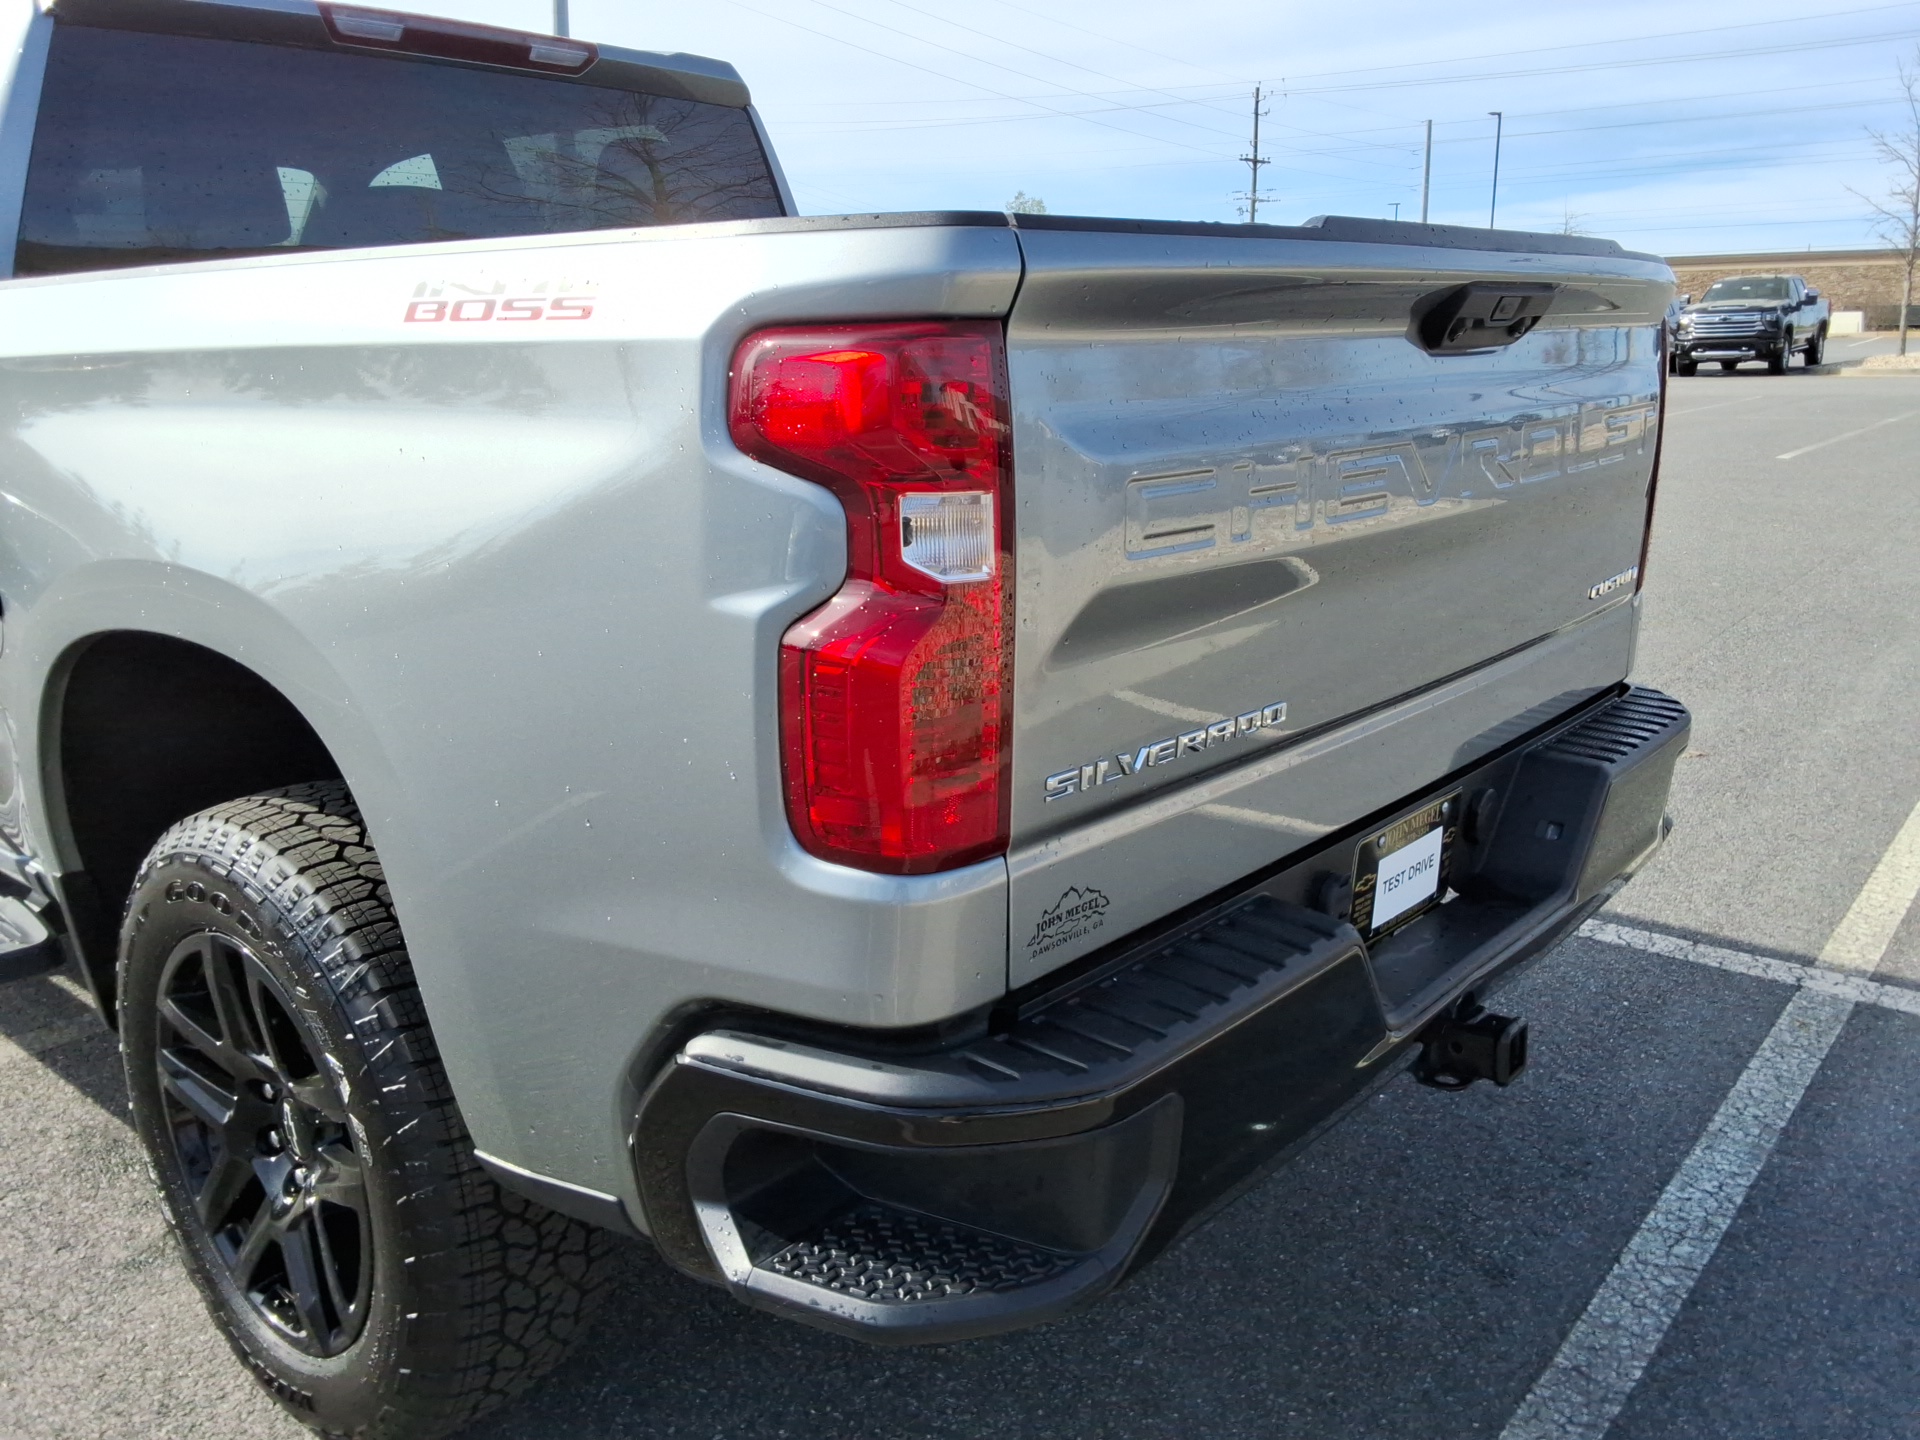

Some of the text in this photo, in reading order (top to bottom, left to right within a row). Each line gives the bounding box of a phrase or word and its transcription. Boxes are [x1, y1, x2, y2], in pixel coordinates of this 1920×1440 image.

[403, 296, 597, 323] BOSS
[1124, 402, 1657, 561] CHEVROLET
[1044, 700, 1288, 803] SILVERADO
[1382, 819, 1411, 854] JOHN
[1410, 804, 1442, 830] MEGEL
[1382, 869, 1407, 895] TEST
[1407, 853, 1436, 881] DRIVE
[1032, 919, 1104, 959] DAWSONVILLE, GA
[1035, 897, 1100, 940] JOHN MEGEL
